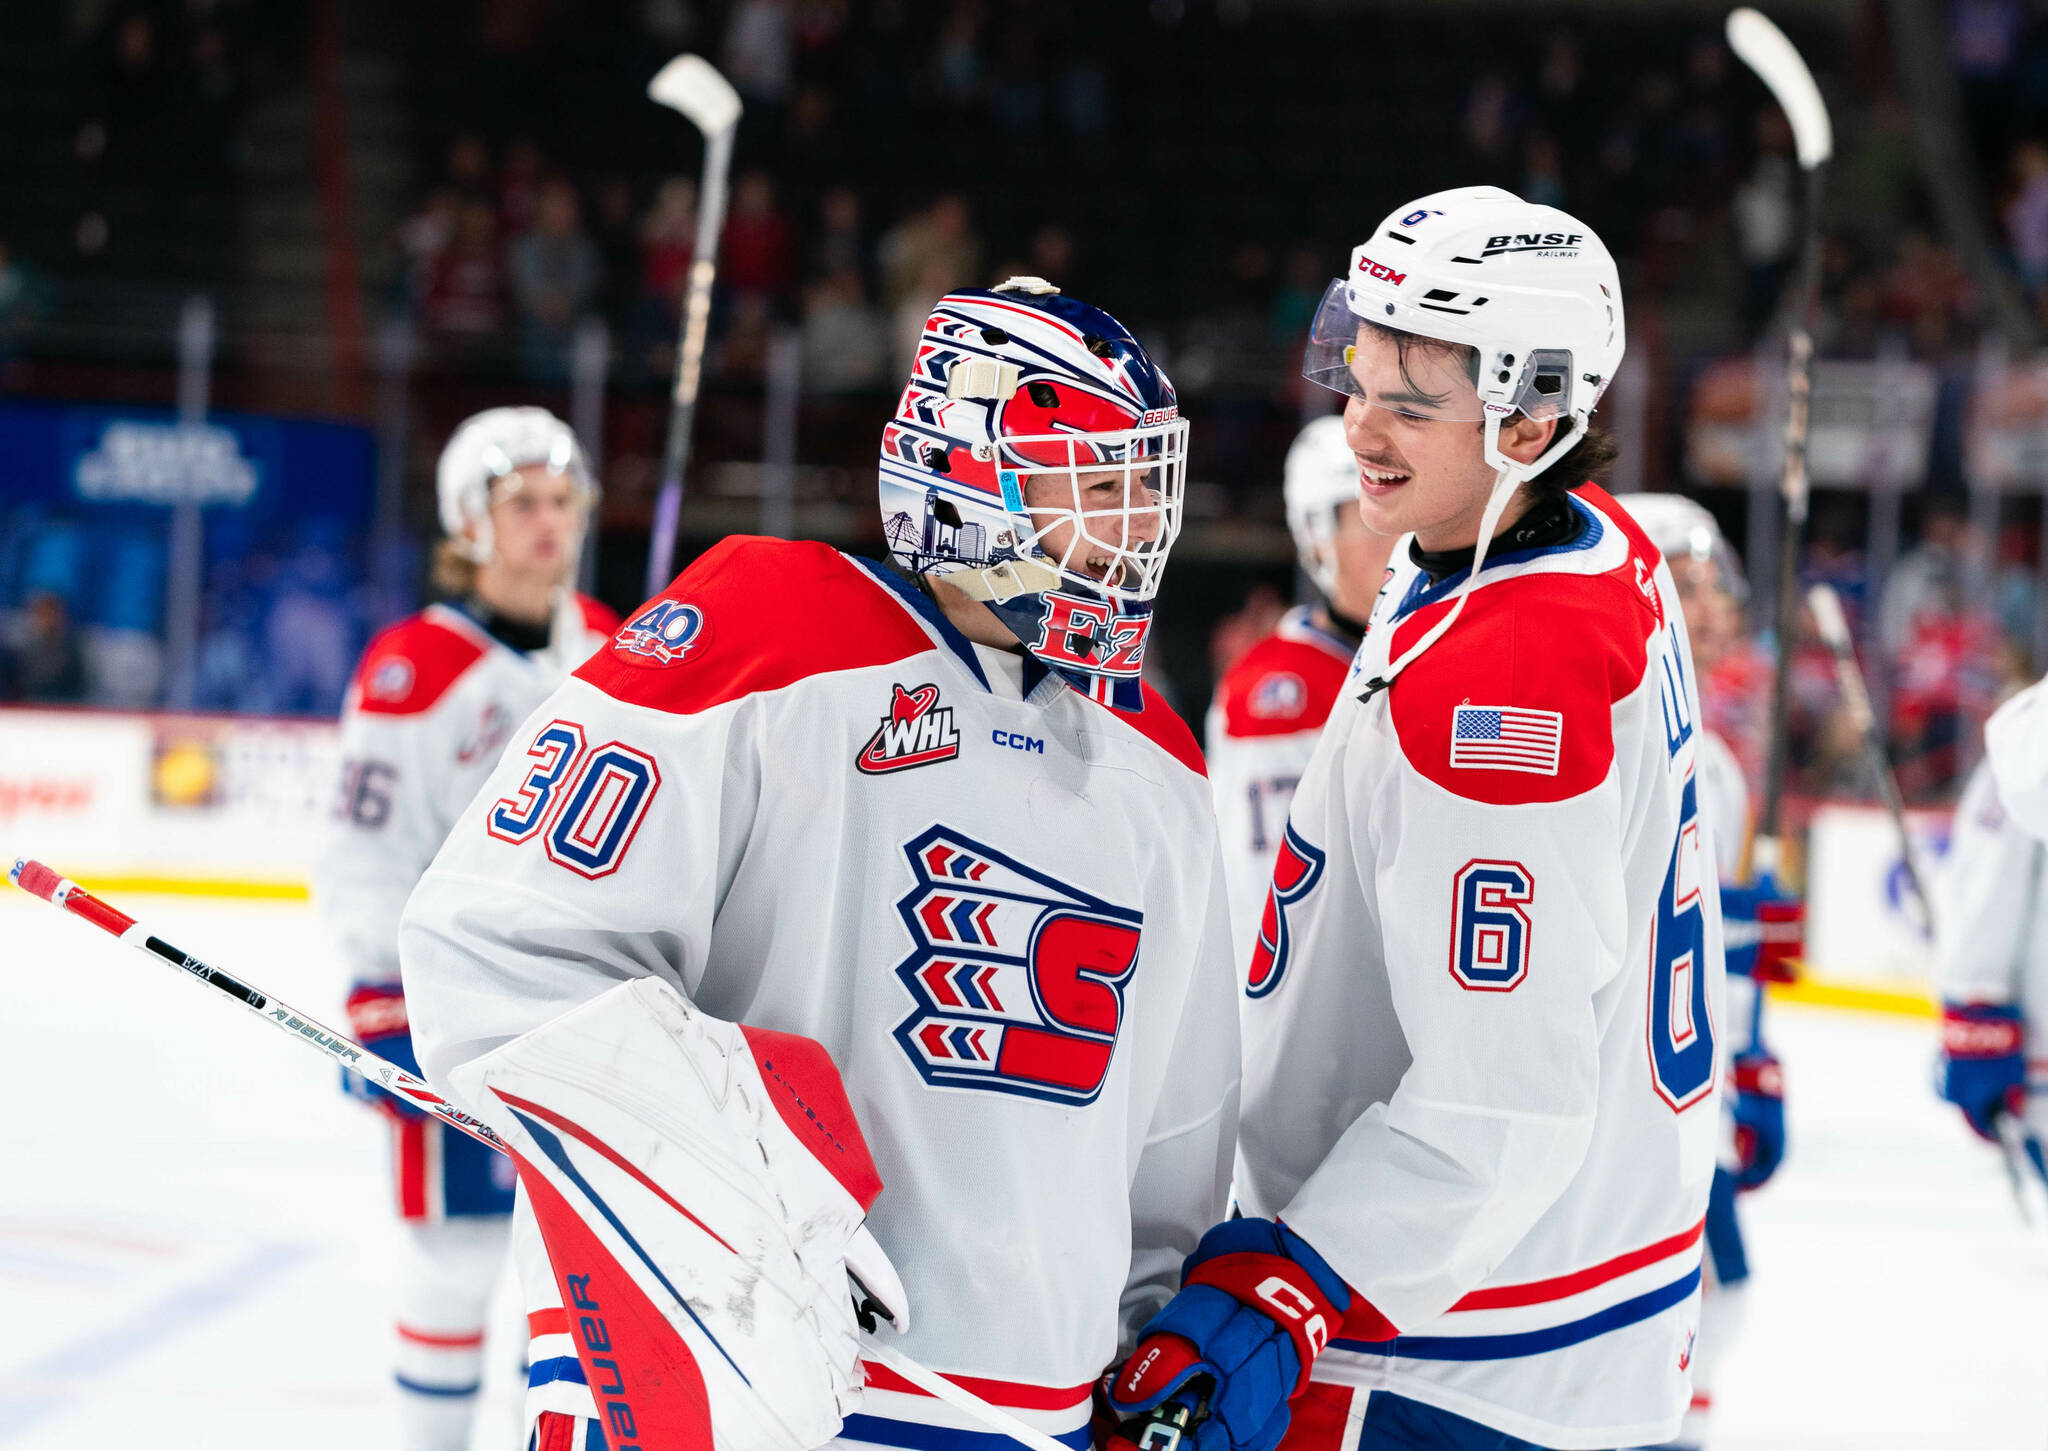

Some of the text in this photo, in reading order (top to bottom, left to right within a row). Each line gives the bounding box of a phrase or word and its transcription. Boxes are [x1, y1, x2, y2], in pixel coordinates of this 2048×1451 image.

[1485, 233, 1583, 249] BNSF
[1536, 250, 1579, 258] RAILWAY
[1359, 256, 1407, 286] CCM
[1486, 404, 1512, 414] CCM
[627, 598, 704, 650] 40
[881, 708, 960, 759] WHL
[991, 729, 1044, 754] CCM
[487, 719, 661, 881] 30
[1449, 858, 1535, 993] 6
[1646, 758, 1718, 1114] 6
[181, 954, 217, 981] EZZY
[284, 1017, 362, 1063] BAUER
[567, 1272, 643, 1451] AUER
[1128, 1347, 1161, 1392] CCM
